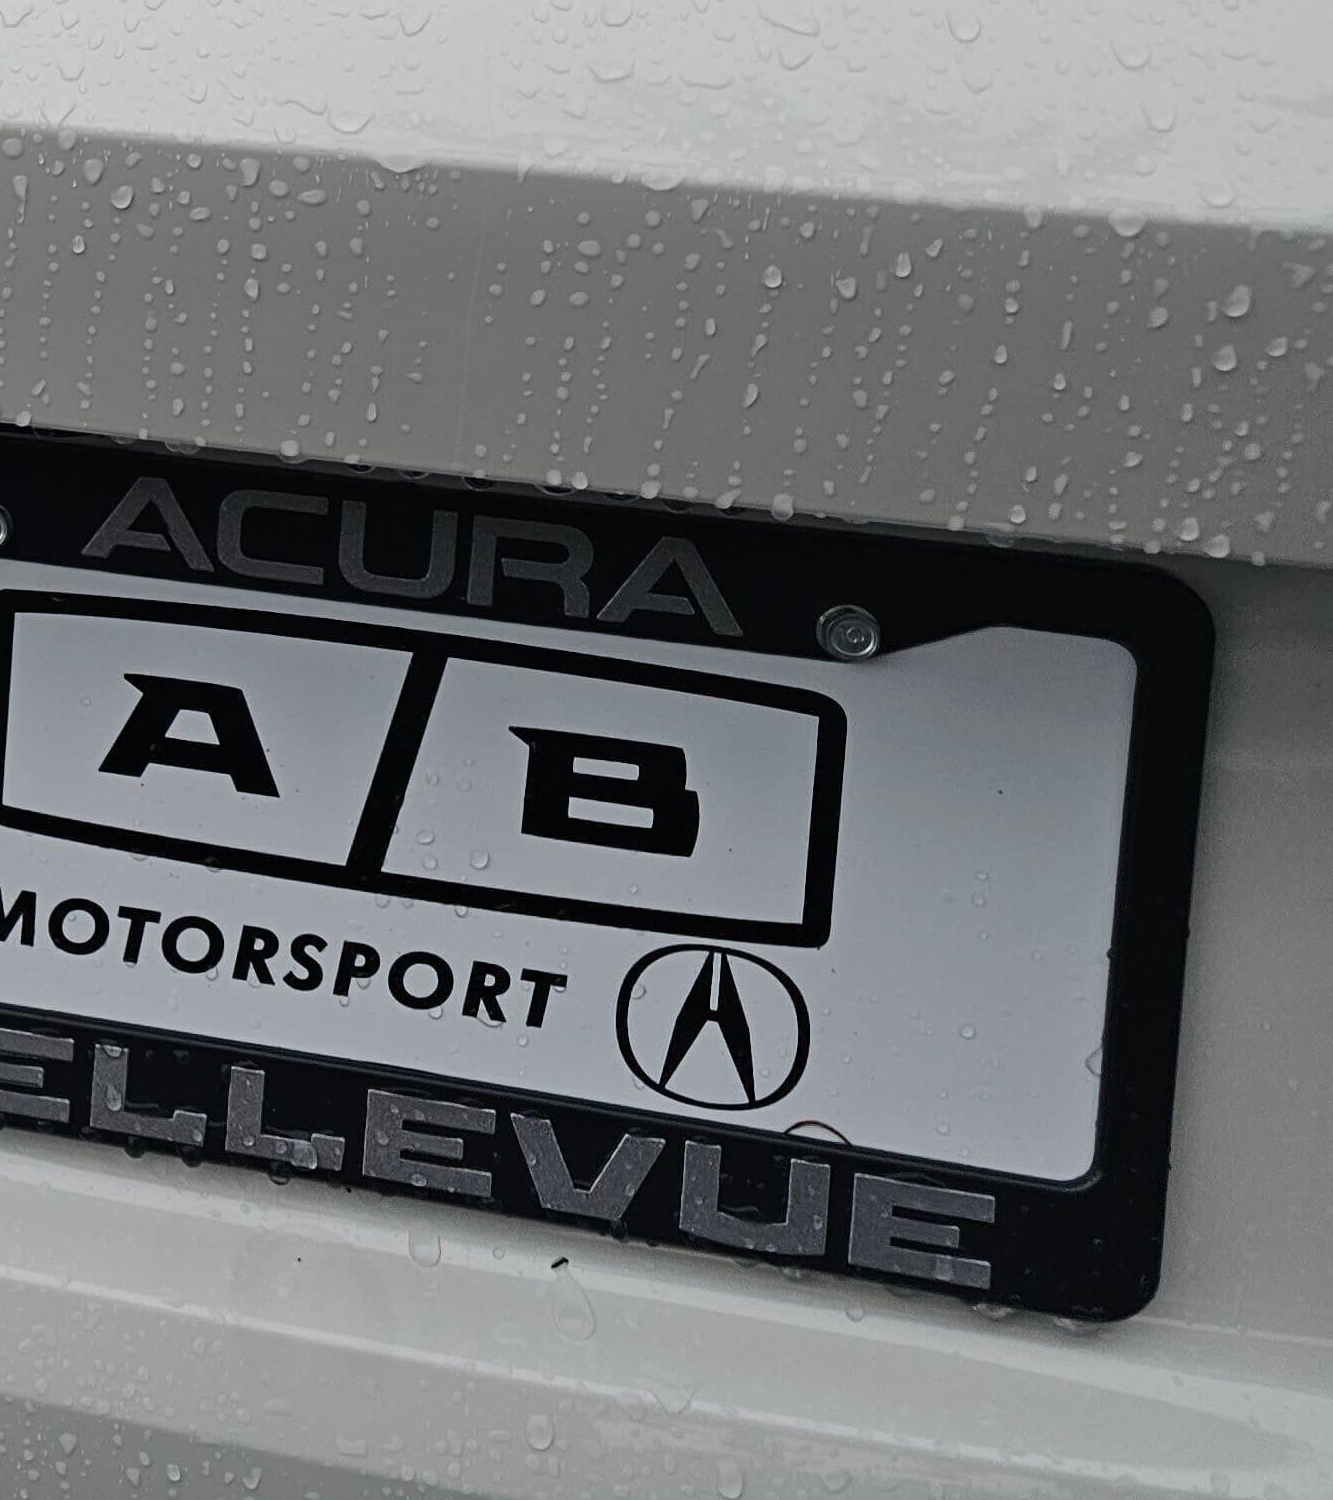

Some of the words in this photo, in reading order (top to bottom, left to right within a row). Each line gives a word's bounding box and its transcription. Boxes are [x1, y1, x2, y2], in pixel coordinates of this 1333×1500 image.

[81, 476, 744, 637] ACURA
[99, 672, 281, 799] A
[508, 725, 701, 858] B
